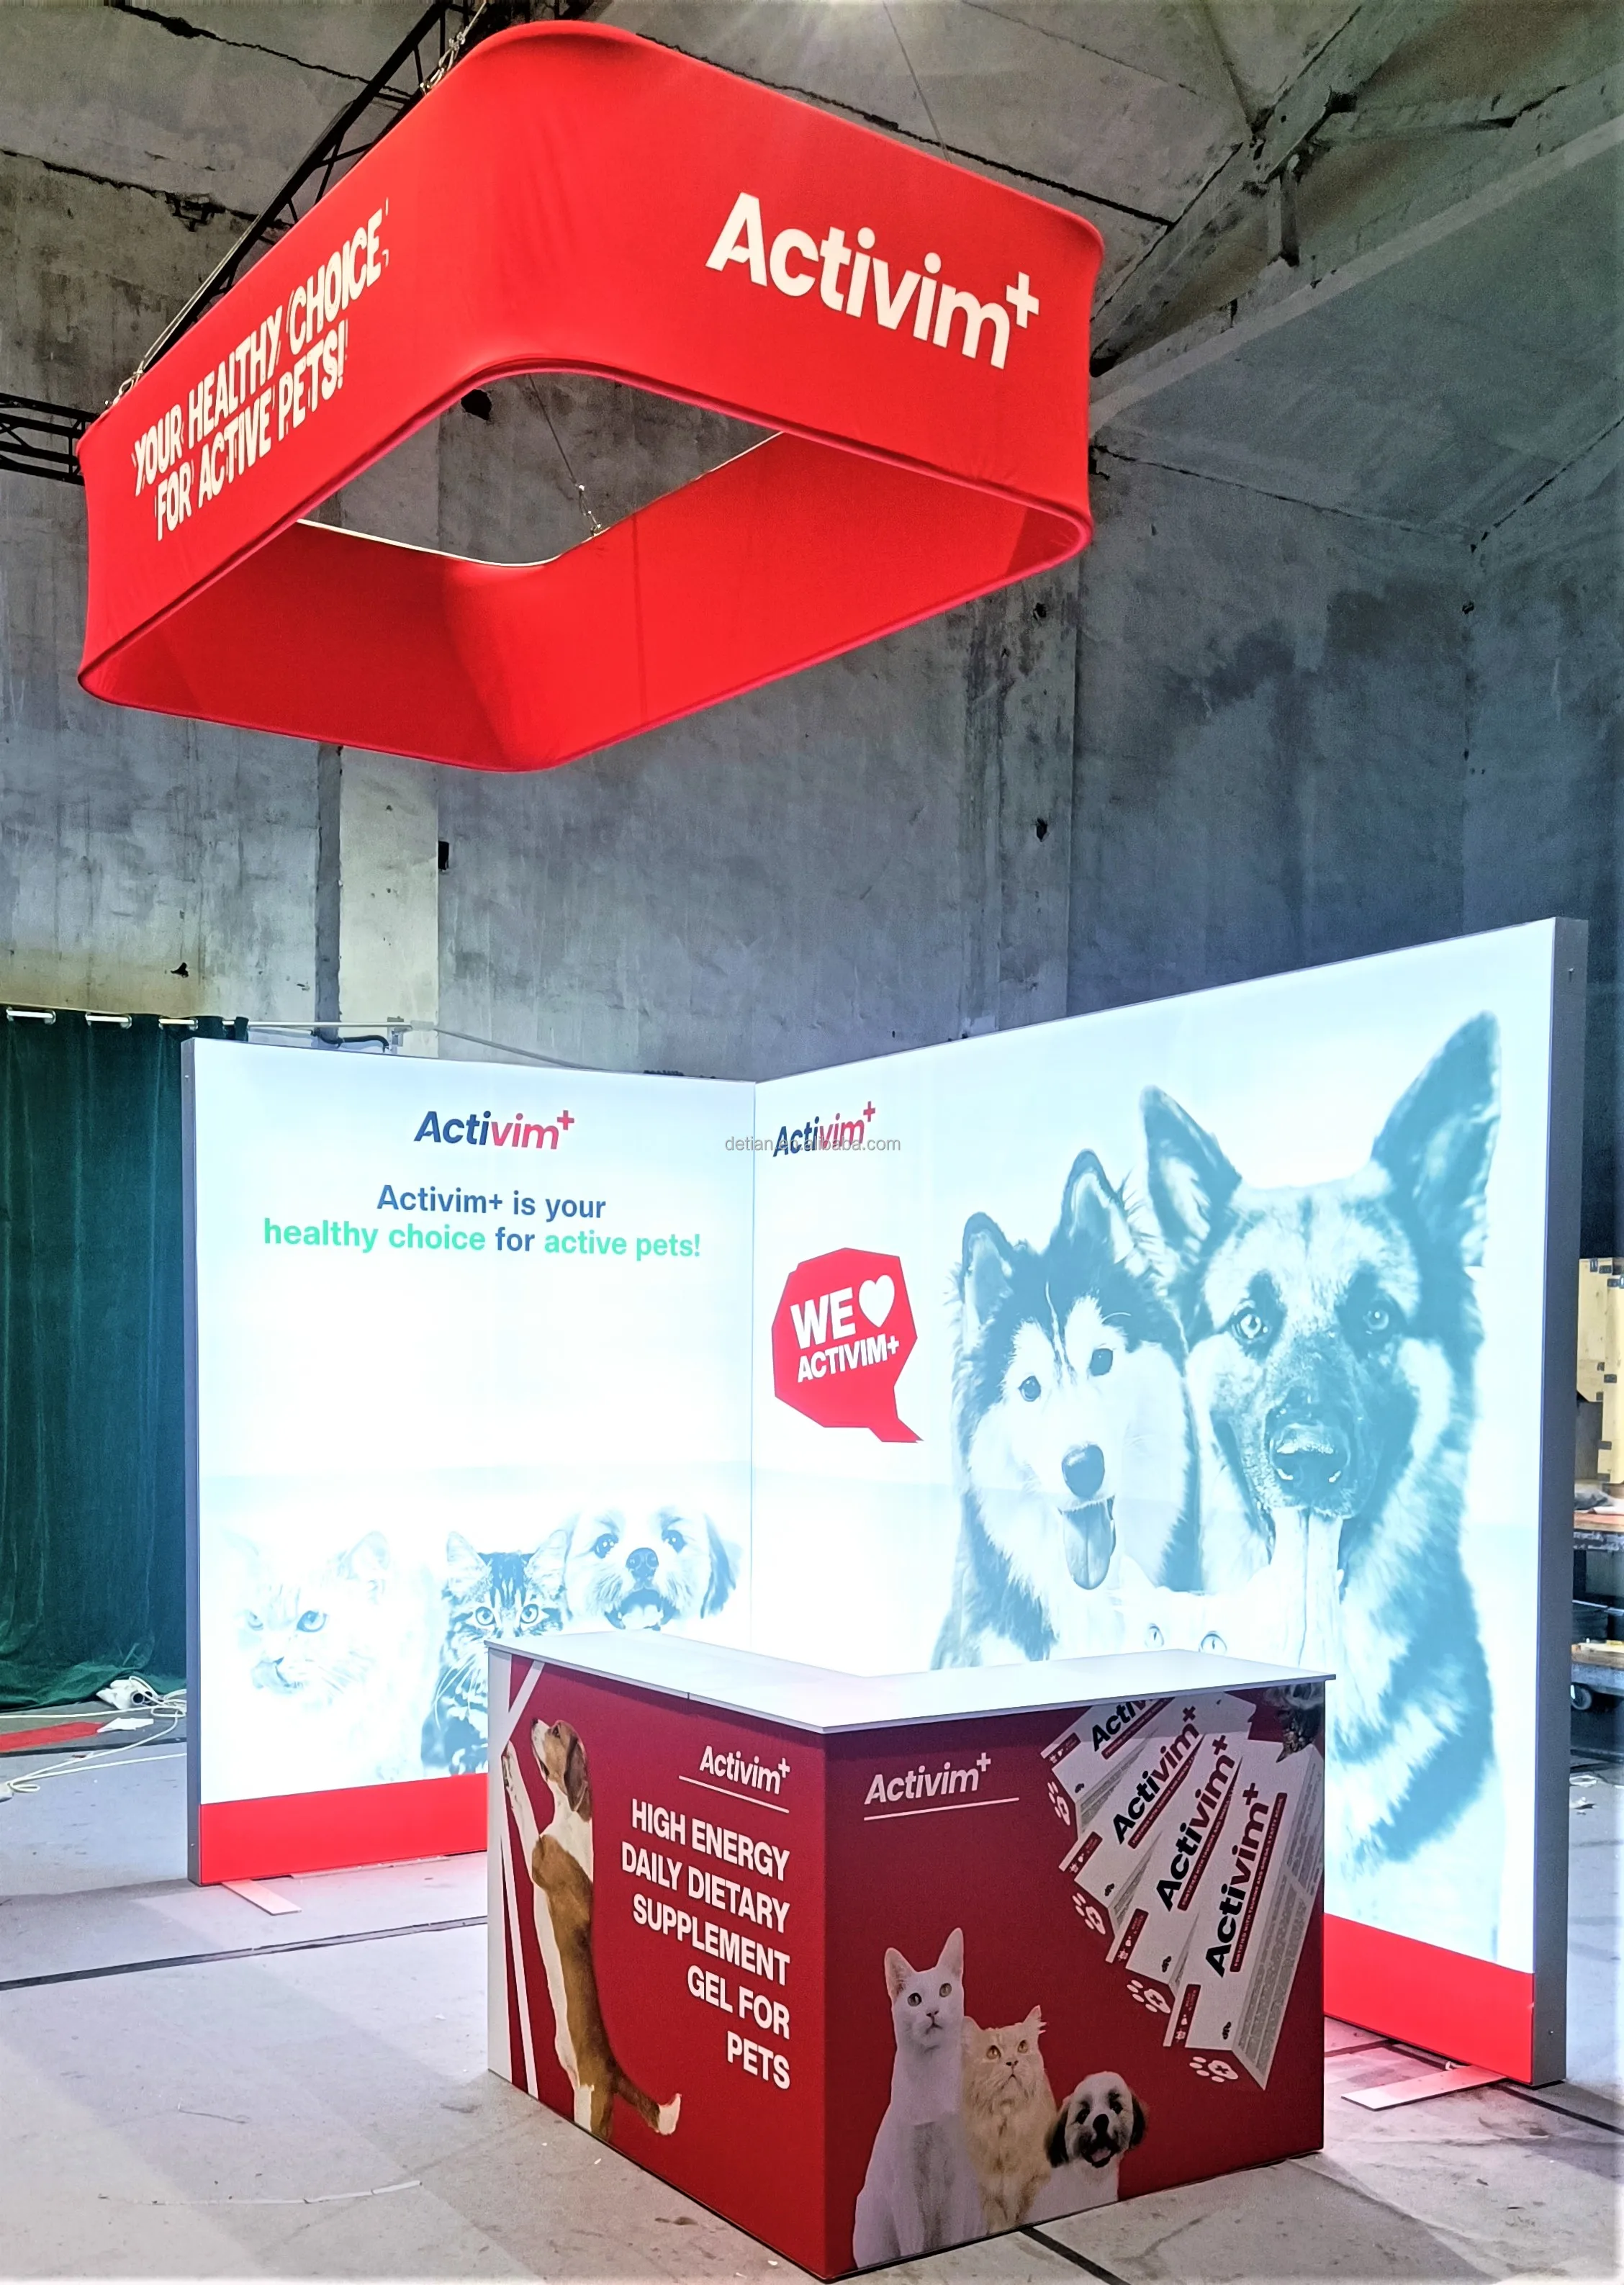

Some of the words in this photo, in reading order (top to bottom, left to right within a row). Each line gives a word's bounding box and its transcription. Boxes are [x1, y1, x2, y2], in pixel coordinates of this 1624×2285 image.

[705, 192, 1039, 369] Activim+
[133, 404, 184, 497] YOUR
[188, 305, 283, 450] HEALTHY
[155, 461, 193, 541] FOR
[198, 387, 272, 508] ACTIVE
[278, 319, 346, 441] PETS!
[413, 1109, 575, 1150] Activim+
[773, 1101, 876, 1158] Activim+
[376, 1184, 502, 1214] Activim+
[513, 1190, 536, 1216] is
[546, 1196, 606, 1222] your
[263, 1217, 379, 1253] healthy
[388, 1222, 486, 1251] choice
[495, 1227, 535, 1252] for
[543, 1228, 628, 1256] active
[636, 1233, 701, 1261] pets!
[790, 1286, 857, 1350] WE
[797, 1333, 900, 1383] ACTIVIM+
[1091, 1698, 1155, 1752] Activ
[699, 1745, 790, 1795] Activim+
[864, 1752, 991, 1805] Activim+
[1113, 1705, 1200, 1845] Activim+
[632, 1798, 686, 1845] HIGH
[692, 1818, 790, 1881] ENERGY
[1156, 1735, 1235, 1912] Activim+
[622, 1841, 682, 1890] DAILY
[688, 1865, 790, 1933] DIETARY
[1205, 1782, 1270, 1978] Activim+
[632, 1893, 790, 1986] SUPPLEMENT
[687, 1965, 733, 2014] GEL
[739, 1986, 790, 2040] FOR
[727, 2030, 790, 2089] PETS
